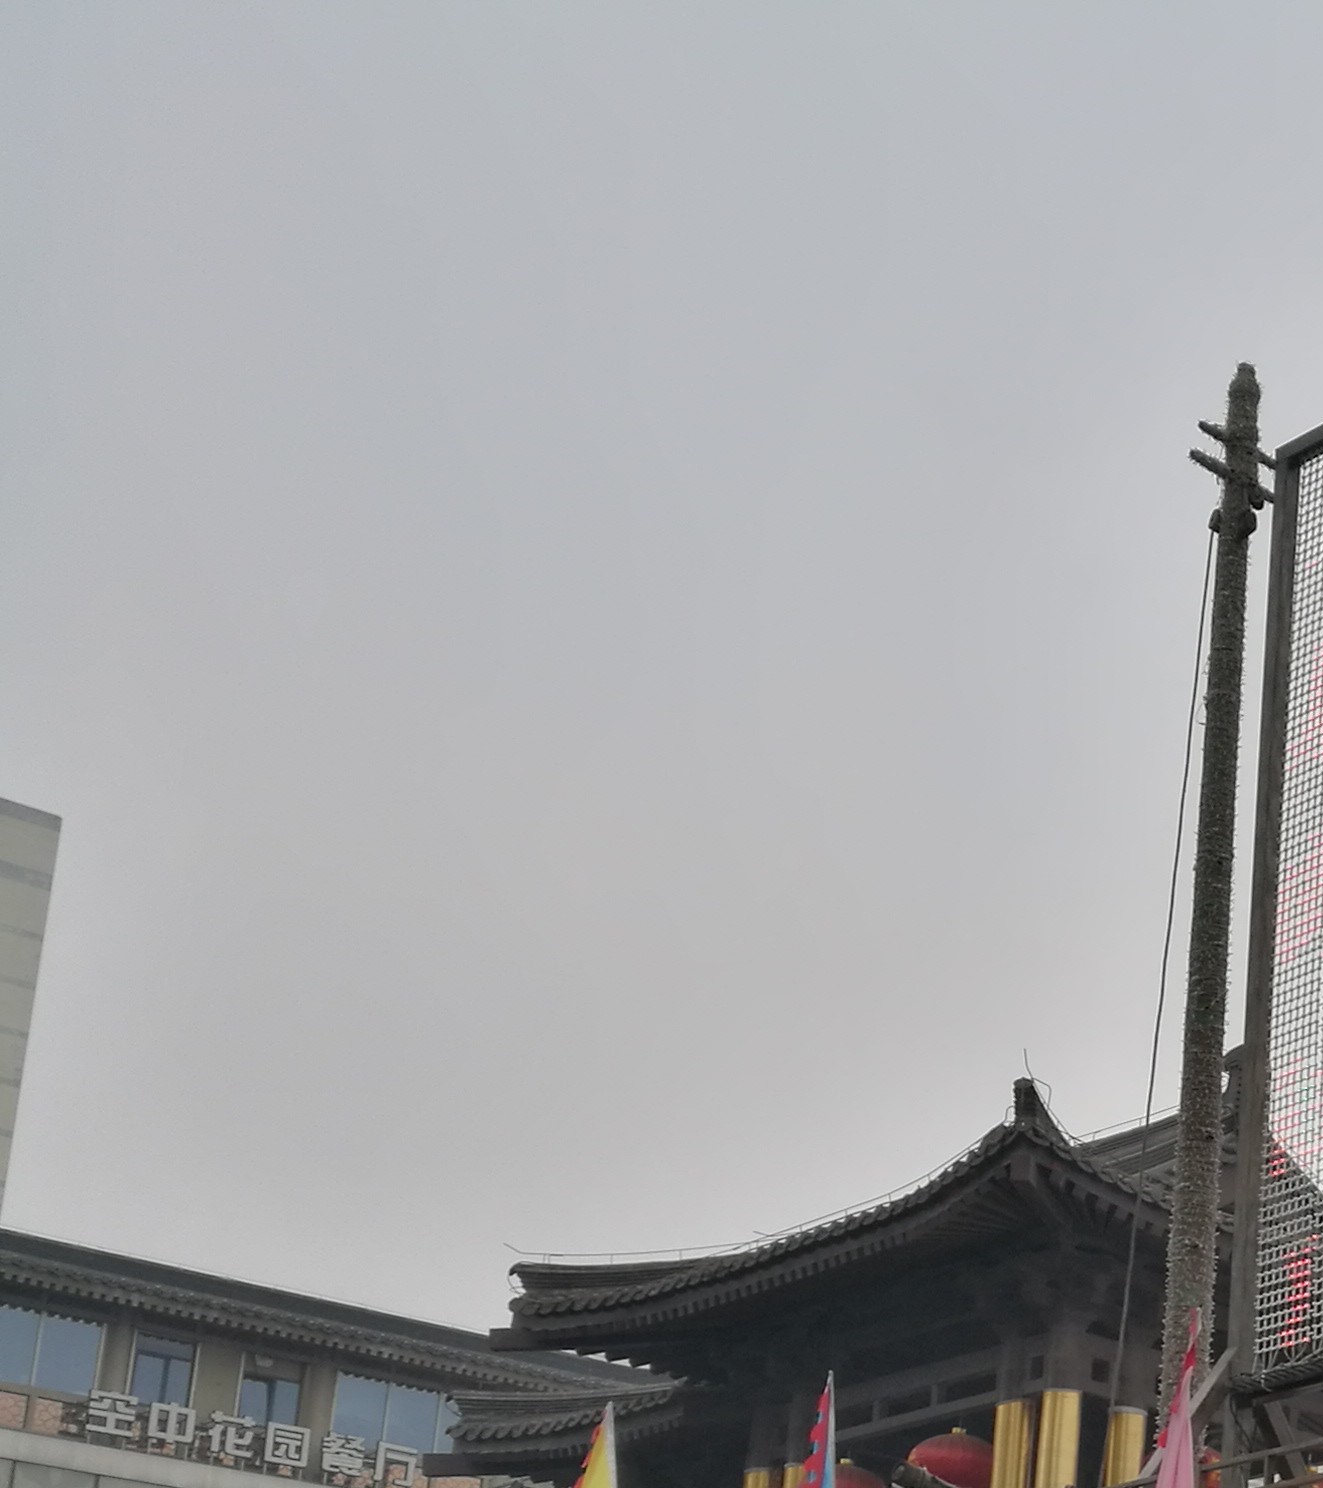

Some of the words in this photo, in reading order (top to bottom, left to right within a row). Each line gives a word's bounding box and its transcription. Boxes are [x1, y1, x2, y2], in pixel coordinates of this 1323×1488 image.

[85, 1388, 419, 1488] 空中花园餐厅
